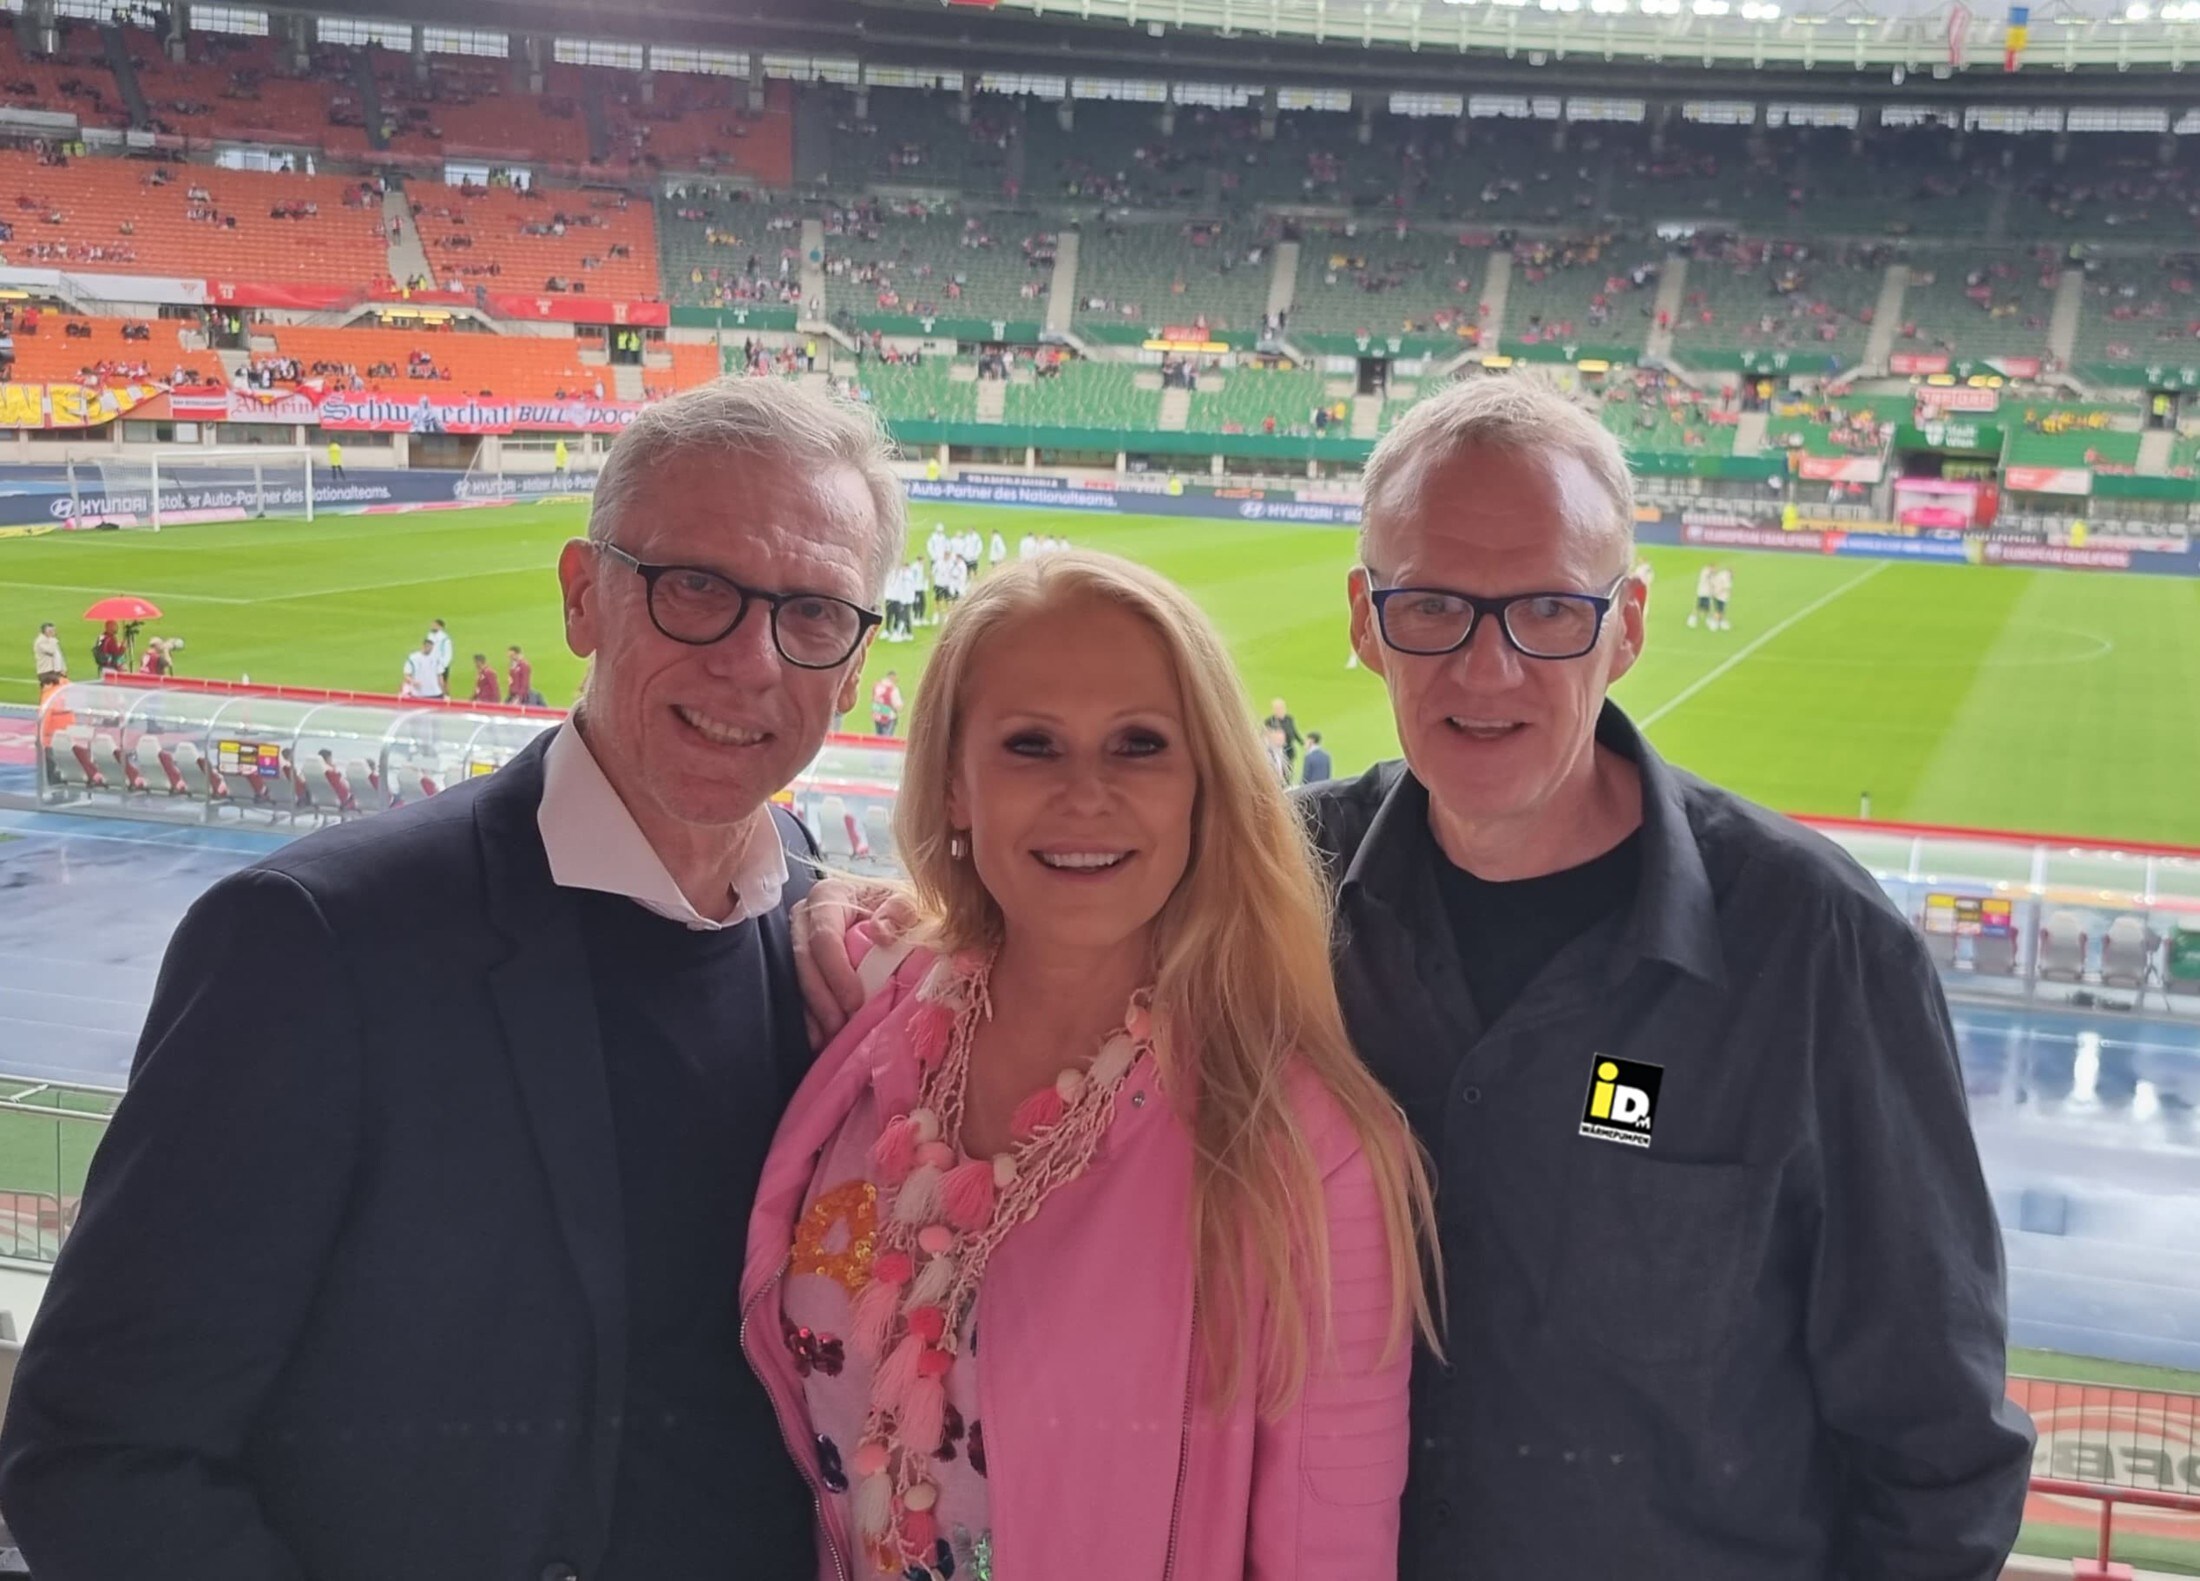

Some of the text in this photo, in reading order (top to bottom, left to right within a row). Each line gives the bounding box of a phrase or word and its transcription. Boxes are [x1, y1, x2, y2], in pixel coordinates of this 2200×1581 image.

[518, 406, 565, 424] BULL
[282, 487, 304, 502] des
[305, 484, 391, 502] ationalteams.
[911, 481, 992, 499] Auto-Partner
[994, 486, 1018, 501] des
[1018, 487, 1118, 508] Nationalteams.
[1267, 502, 1334, 521] HYUNDAI
